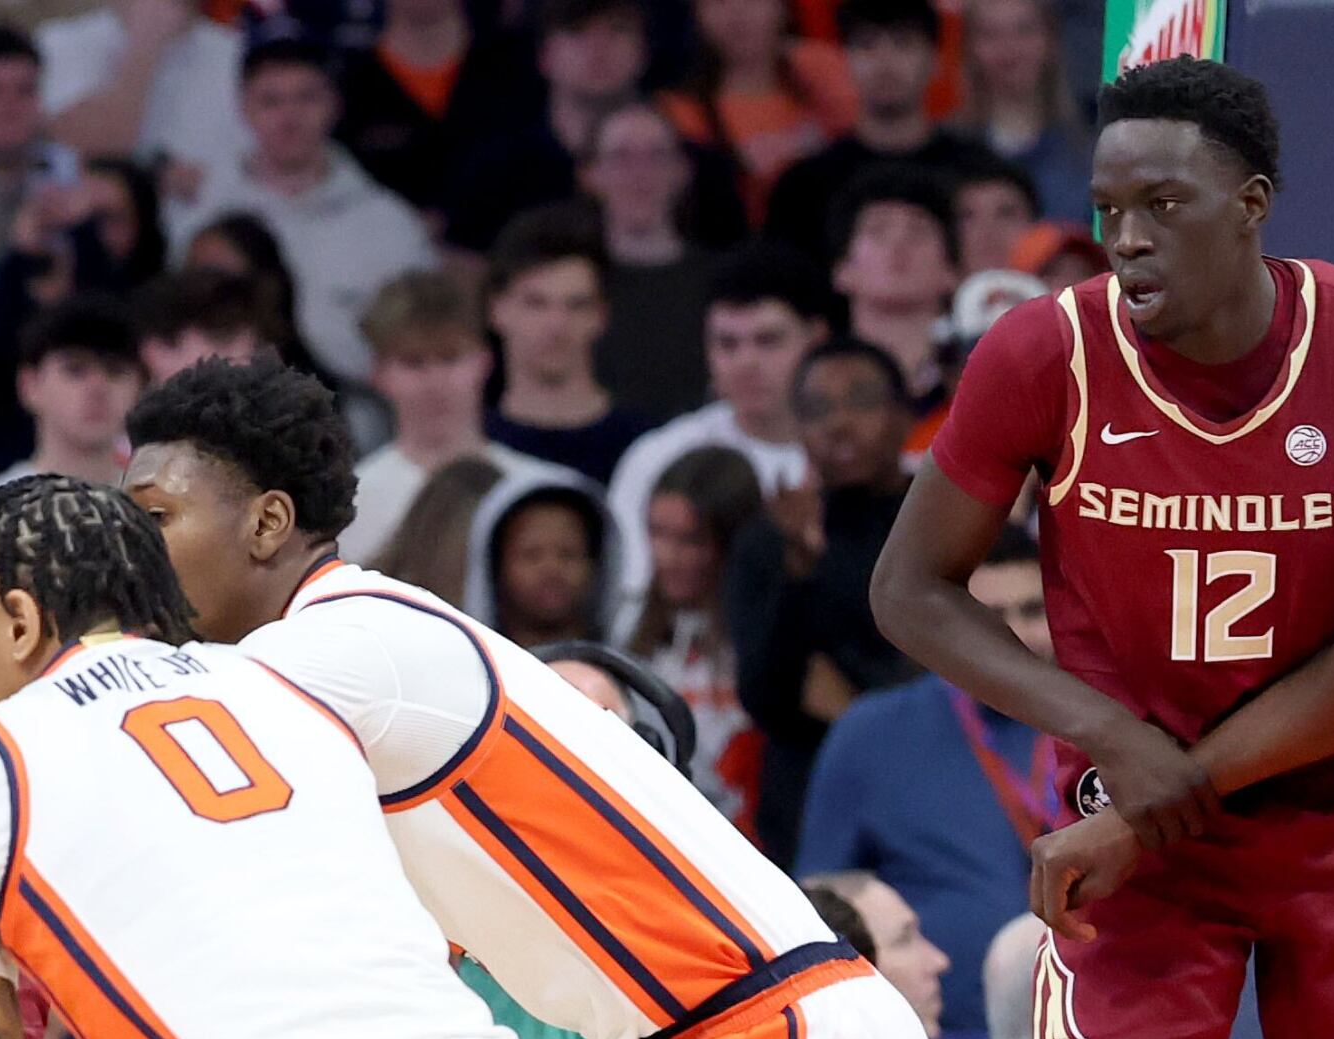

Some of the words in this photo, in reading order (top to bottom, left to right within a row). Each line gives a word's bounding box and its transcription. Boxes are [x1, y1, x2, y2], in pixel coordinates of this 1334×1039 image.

[1293, 438, 1321, 450] ACC
[1164, 549, 1277, 663] 12
[119, 695, 294, 824] 0
